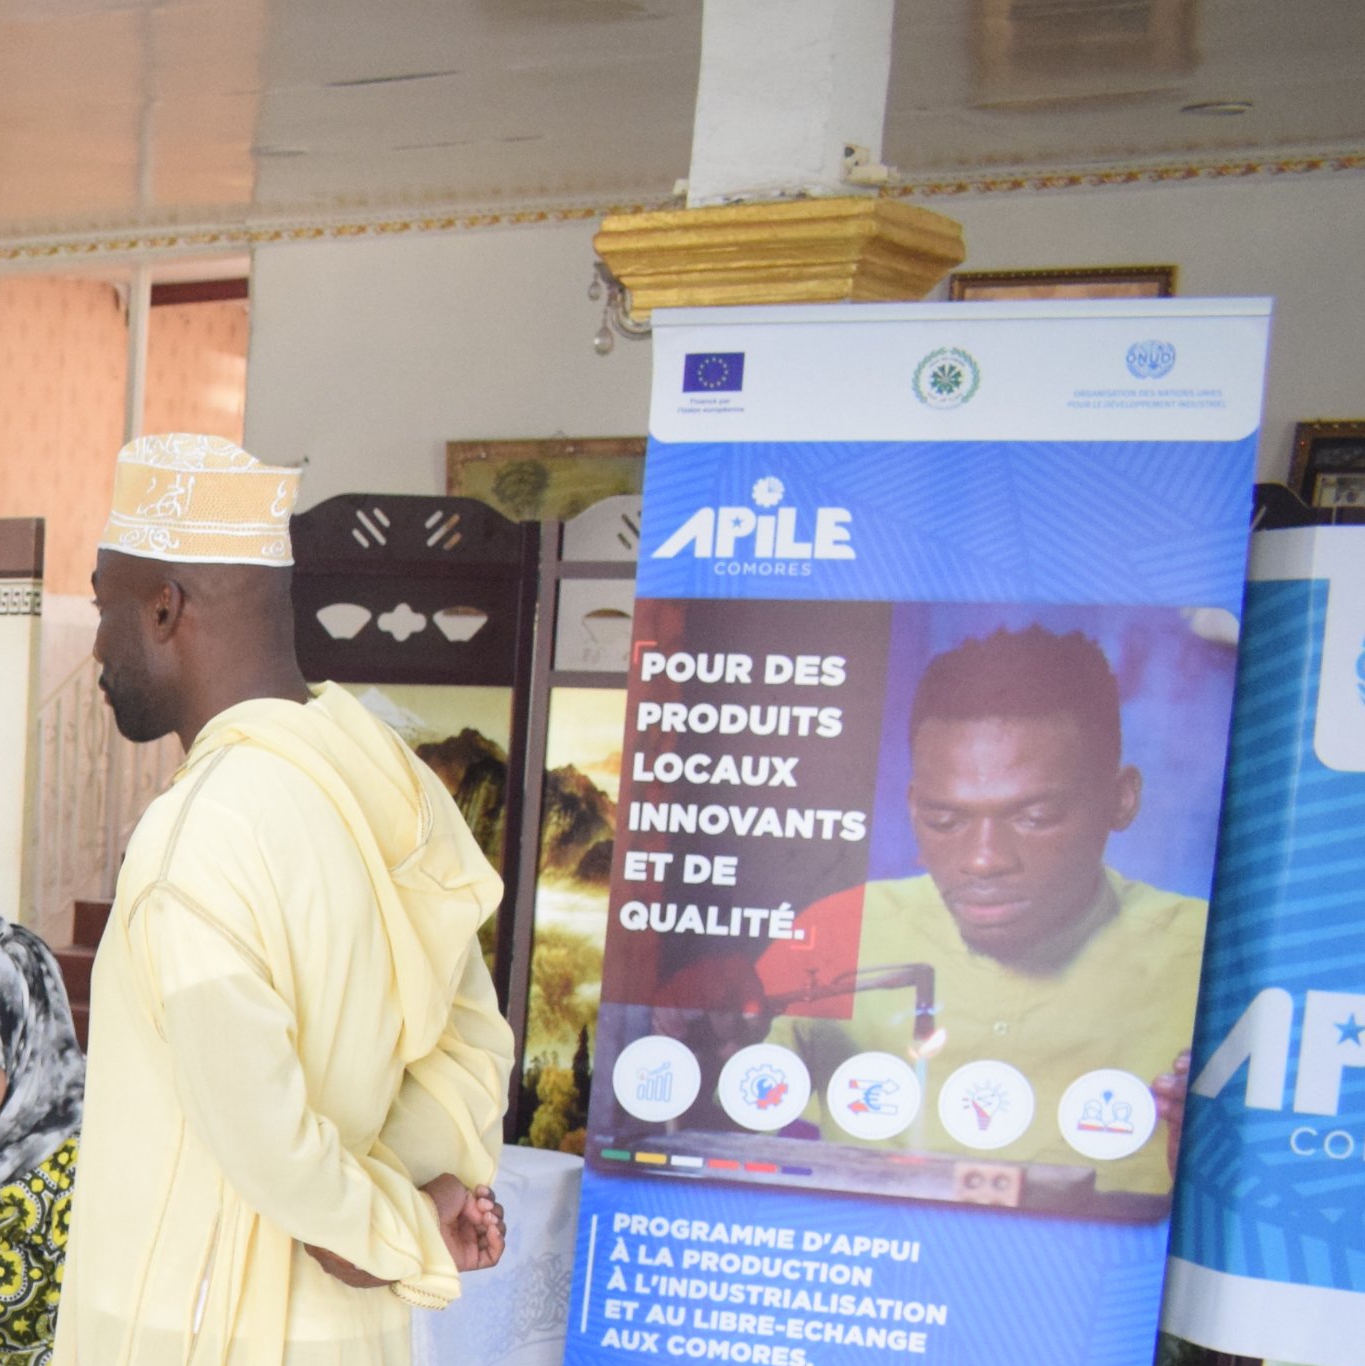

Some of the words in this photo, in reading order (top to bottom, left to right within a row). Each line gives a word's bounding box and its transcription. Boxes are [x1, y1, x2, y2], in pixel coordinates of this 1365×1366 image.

[713, 561, 812, 577] COMORES
[641, 653, 752, 683] POUR
[764, 655, 846, 686] DES
[638, 703, 842, 737] PRODUITS
[634, 753, 798, 787] LOCAUX
[629, 803, 866, 841] INNOVANTS
[624, 852, 673, 882] ET
[683, 854, 738, 886] DE
[618, 900, 806, 941] QUALITÉ.
[1290, 1126, 1365, 1160] CO
[613, 1212, 795, 1249] PROGRAMME
[803, 1231, 920, 1262] D'APPUI
[609, 1237, 630, 1263] À
[638, 1246, 674, 1267] LA
[683, 1250, 873, 1287] PRODUCTION
[606, 1266, 627, 1291] À
[635, 1273, 947, 1326] L'INDUSTRIALISATION
[602, 1328, 659, 1352] AUX
[604, 1299, 638, 1319] ET
[646, 1304, 686, 1326] AU
[694, 1309, 927, 1353] LIBRE-ECHANGE
